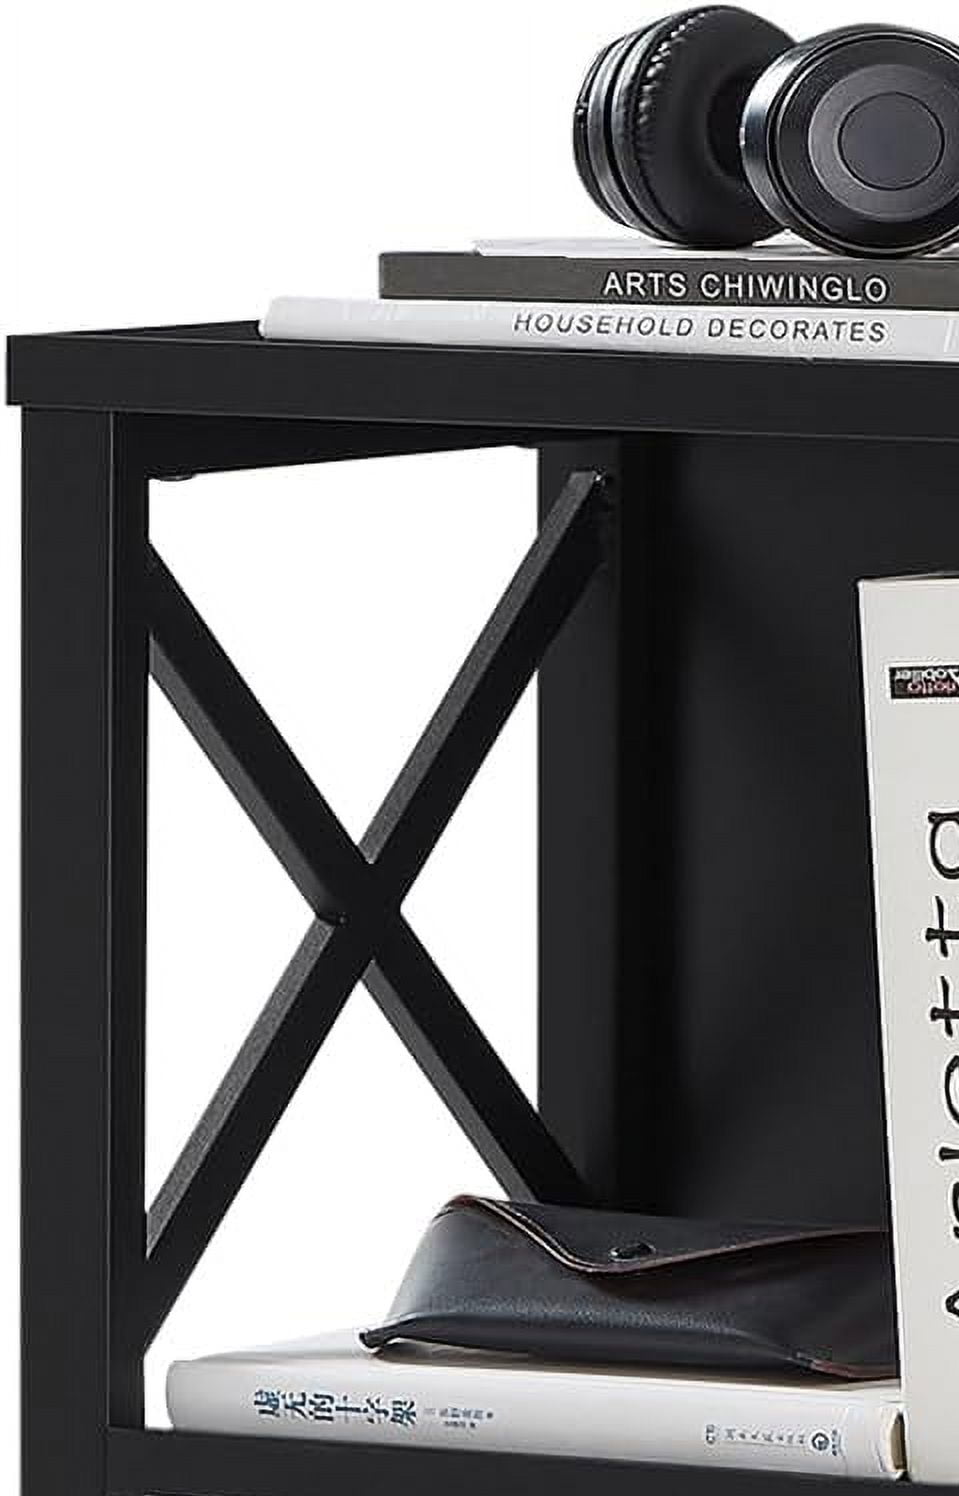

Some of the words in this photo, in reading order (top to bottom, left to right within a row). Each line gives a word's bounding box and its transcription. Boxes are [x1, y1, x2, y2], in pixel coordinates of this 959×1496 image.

[603, 272, 687, 299] ARTS
[700, 272, 888, 302] CHIWINGLO
[512, 311, 694, 338] HOUSEHOLD
[706, 316, 888, 343] DECORATES
